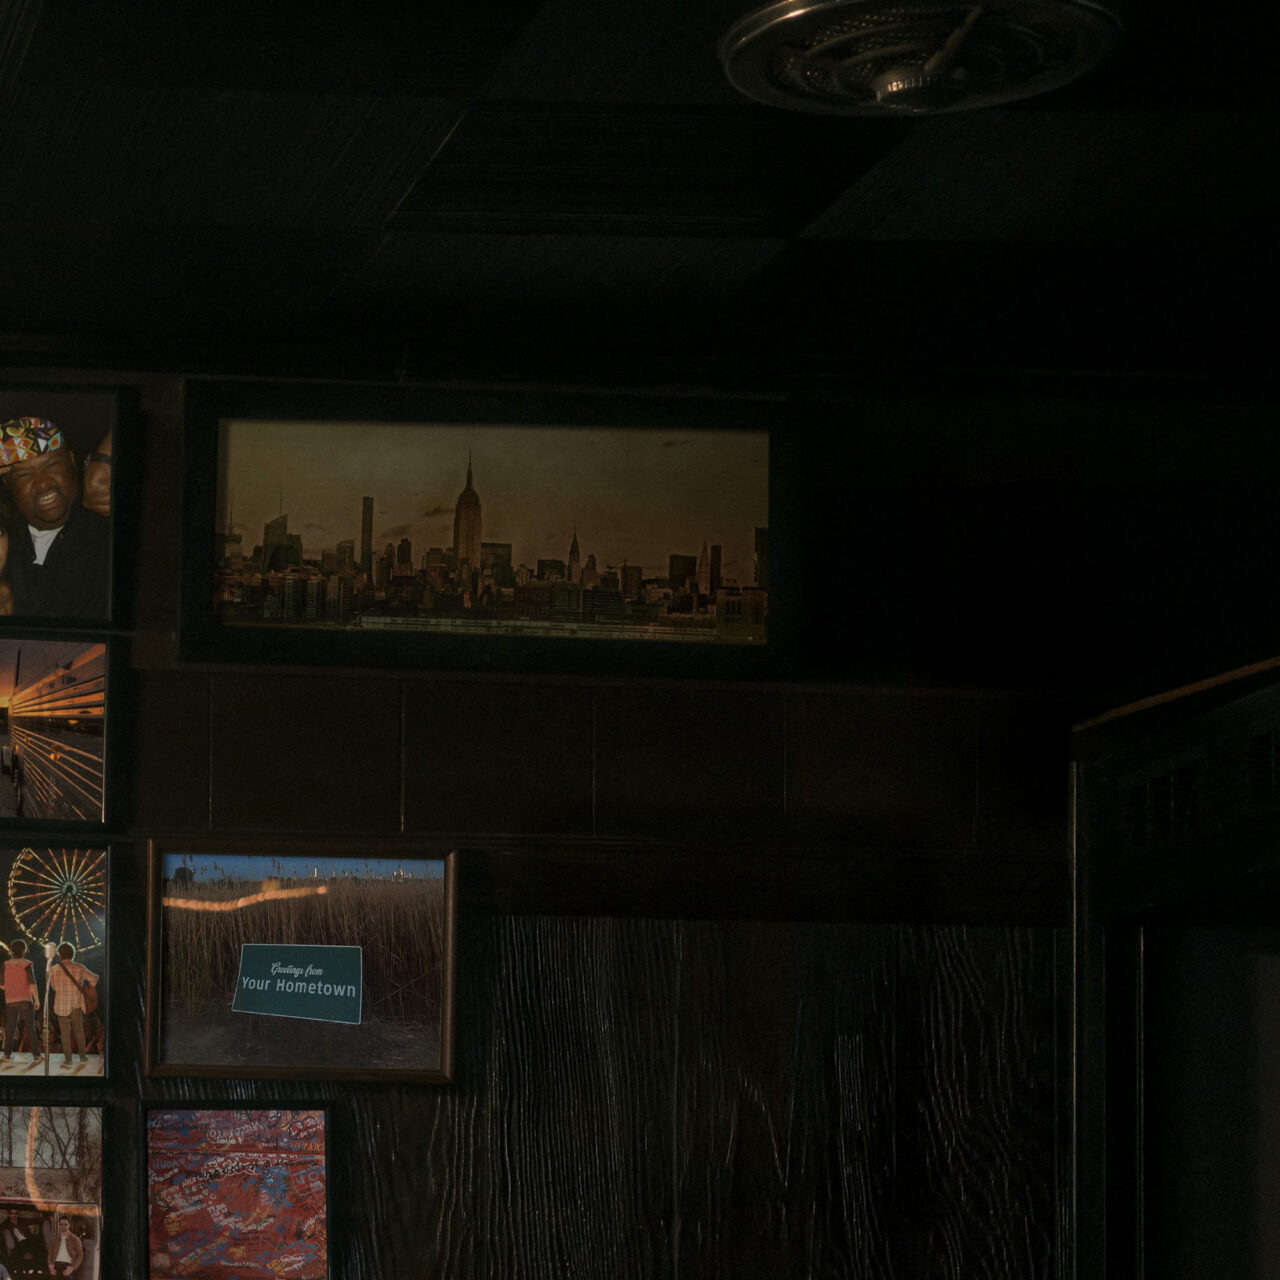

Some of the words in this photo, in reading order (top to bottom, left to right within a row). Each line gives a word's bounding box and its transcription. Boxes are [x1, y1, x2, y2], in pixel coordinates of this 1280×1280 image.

[270, 962, 303, 977] Greetings
[304, 964, 324, 977] from
[242, 976, 271, 990] Your
[276, 979, 356, 997] Hometown
